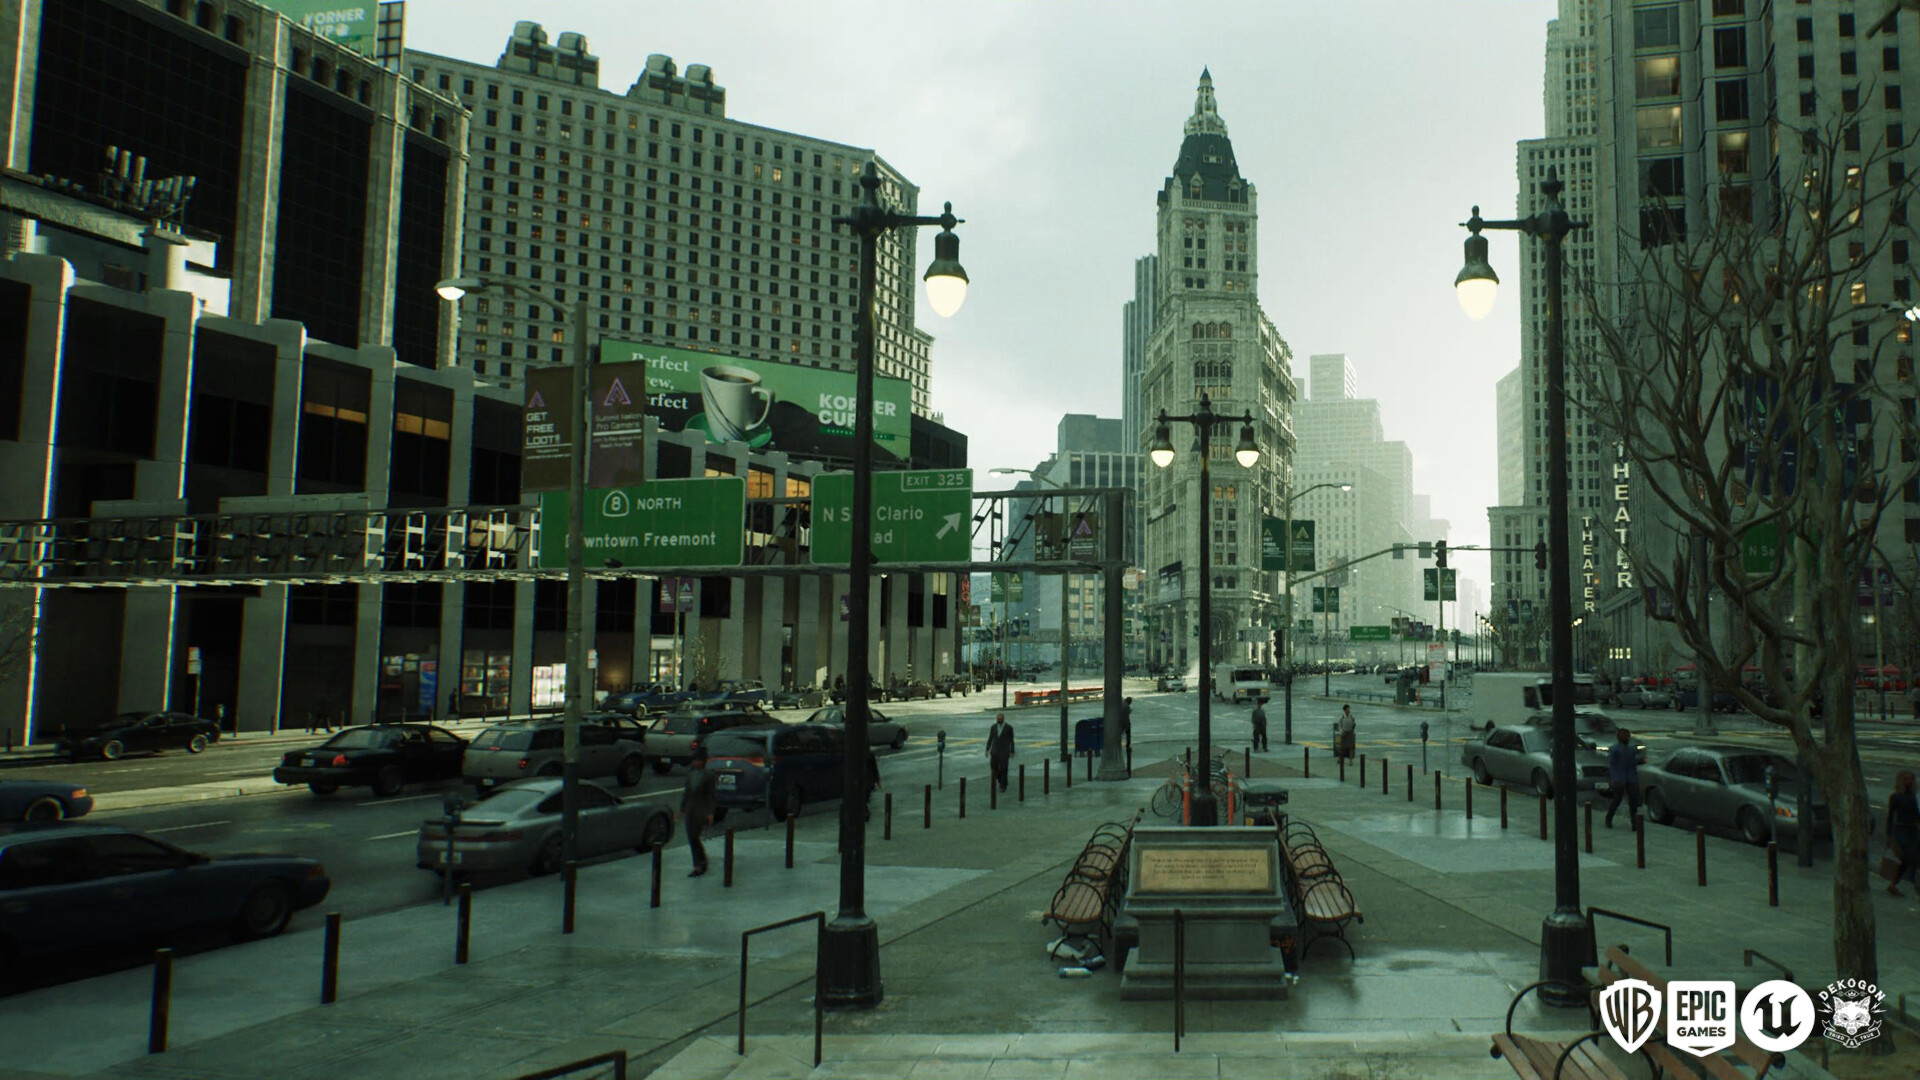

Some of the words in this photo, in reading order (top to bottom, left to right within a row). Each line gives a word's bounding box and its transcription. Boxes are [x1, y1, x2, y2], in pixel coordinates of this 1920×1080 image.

[313, 24, 335, 37] UP
[645, 376, 675, 390] ew,
[645, 392, 689, 410] rfect
[819, 393, 897, 416] KORER
[526, 411, 548, 422] GET
[526, 423, 555, 433] FREE
[906, 476, 930, 486] EXIT
[938, 474, 964, 486] 325
[610, 496, 621, 511] 8
[637, 497, 682, 510] NORTH
[823, 507, 834, 522] N
[876, 505, 924, 520] Clario
[565, 532, 639, 548] wntown
[643, 531, 717, 546] Freemont
[873, 529, 893, 544] ad
[1760, 545, 1776, 557] Sa
[1582, 516, 1595, 612] THEATER
